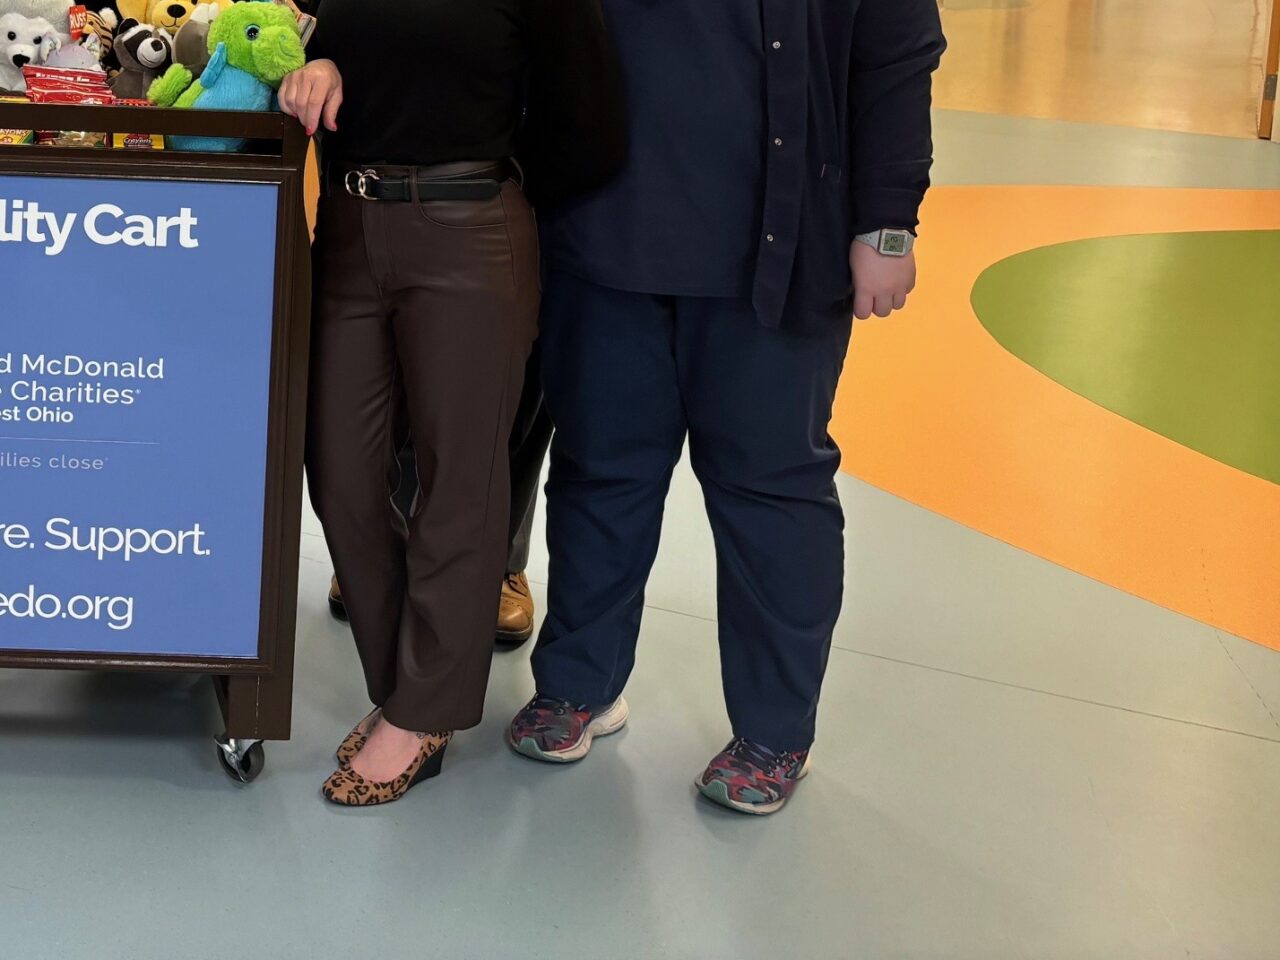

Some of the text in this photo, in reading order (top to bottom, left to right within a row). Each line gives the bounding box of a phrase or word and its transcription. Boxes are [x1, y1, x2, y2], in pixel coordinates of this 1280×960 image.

[70, 12, 87, 29] RUSS
[84, 203, 199, 249] Cart
[21, 353, 164, 379] McDonald
[26, 406, 74, 423] Ohio
[48, 453, 104, 470] close
[44, 517, 211, 562] Support.
